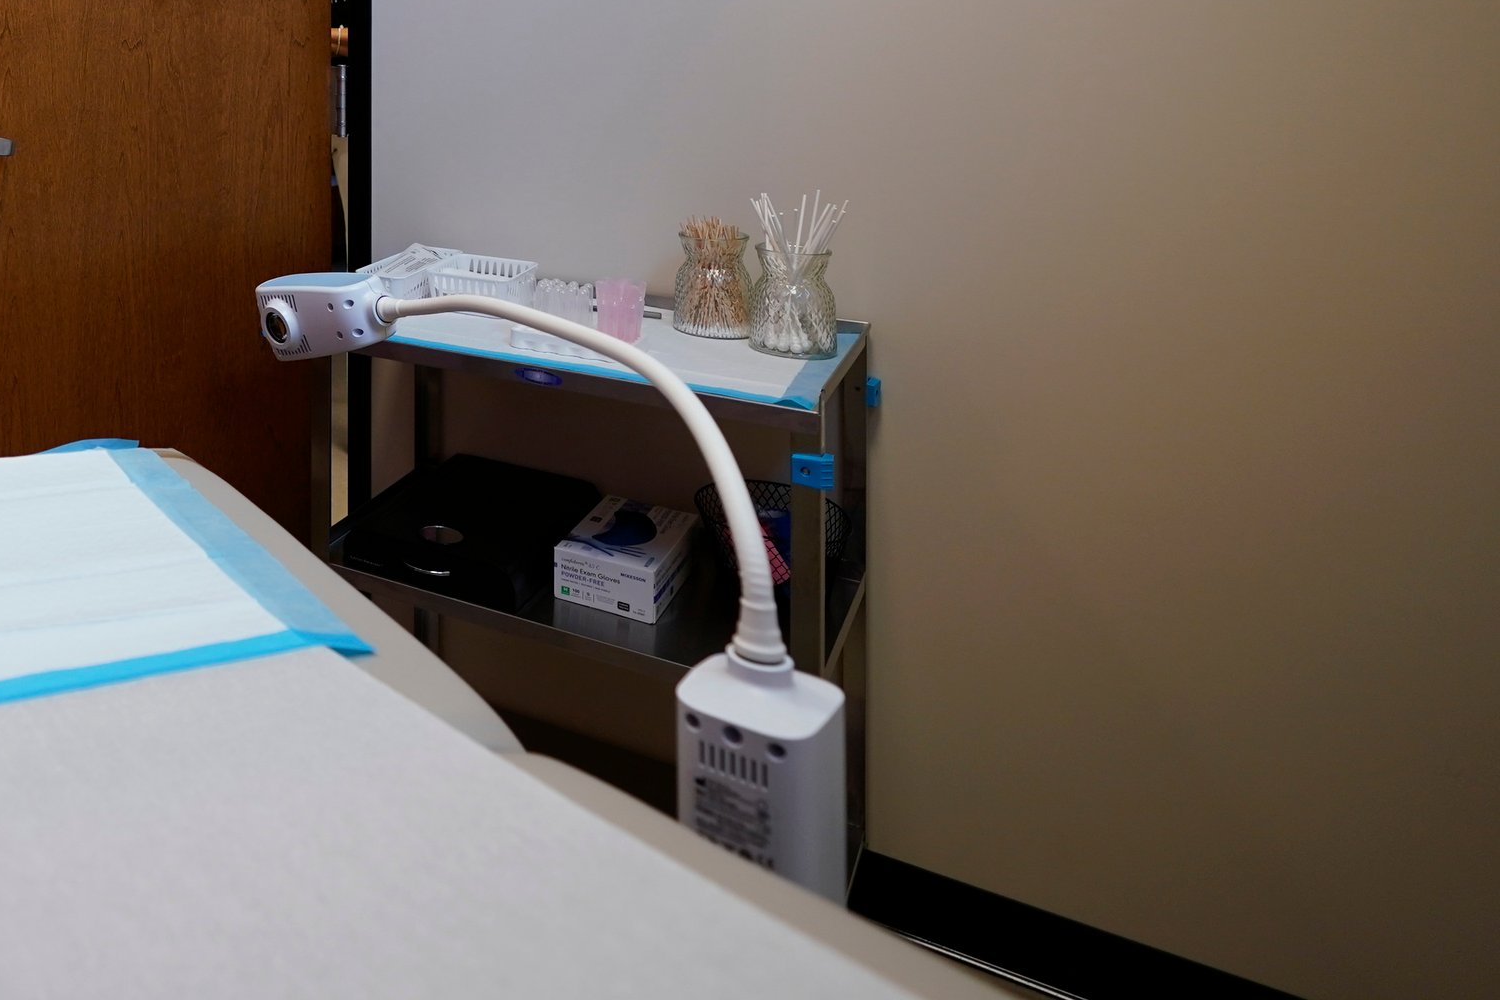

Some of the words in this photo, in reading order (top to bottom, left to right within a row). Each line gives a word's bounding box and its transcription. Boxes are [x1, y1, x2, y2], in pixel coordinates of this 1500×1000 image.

[561, 564, 578, 574] Nitrile
[579, 568, 597, 578] Exam
[598, 573, 621, 585] Gloves
[561, 571, 605, 587] POWDER-FREE
